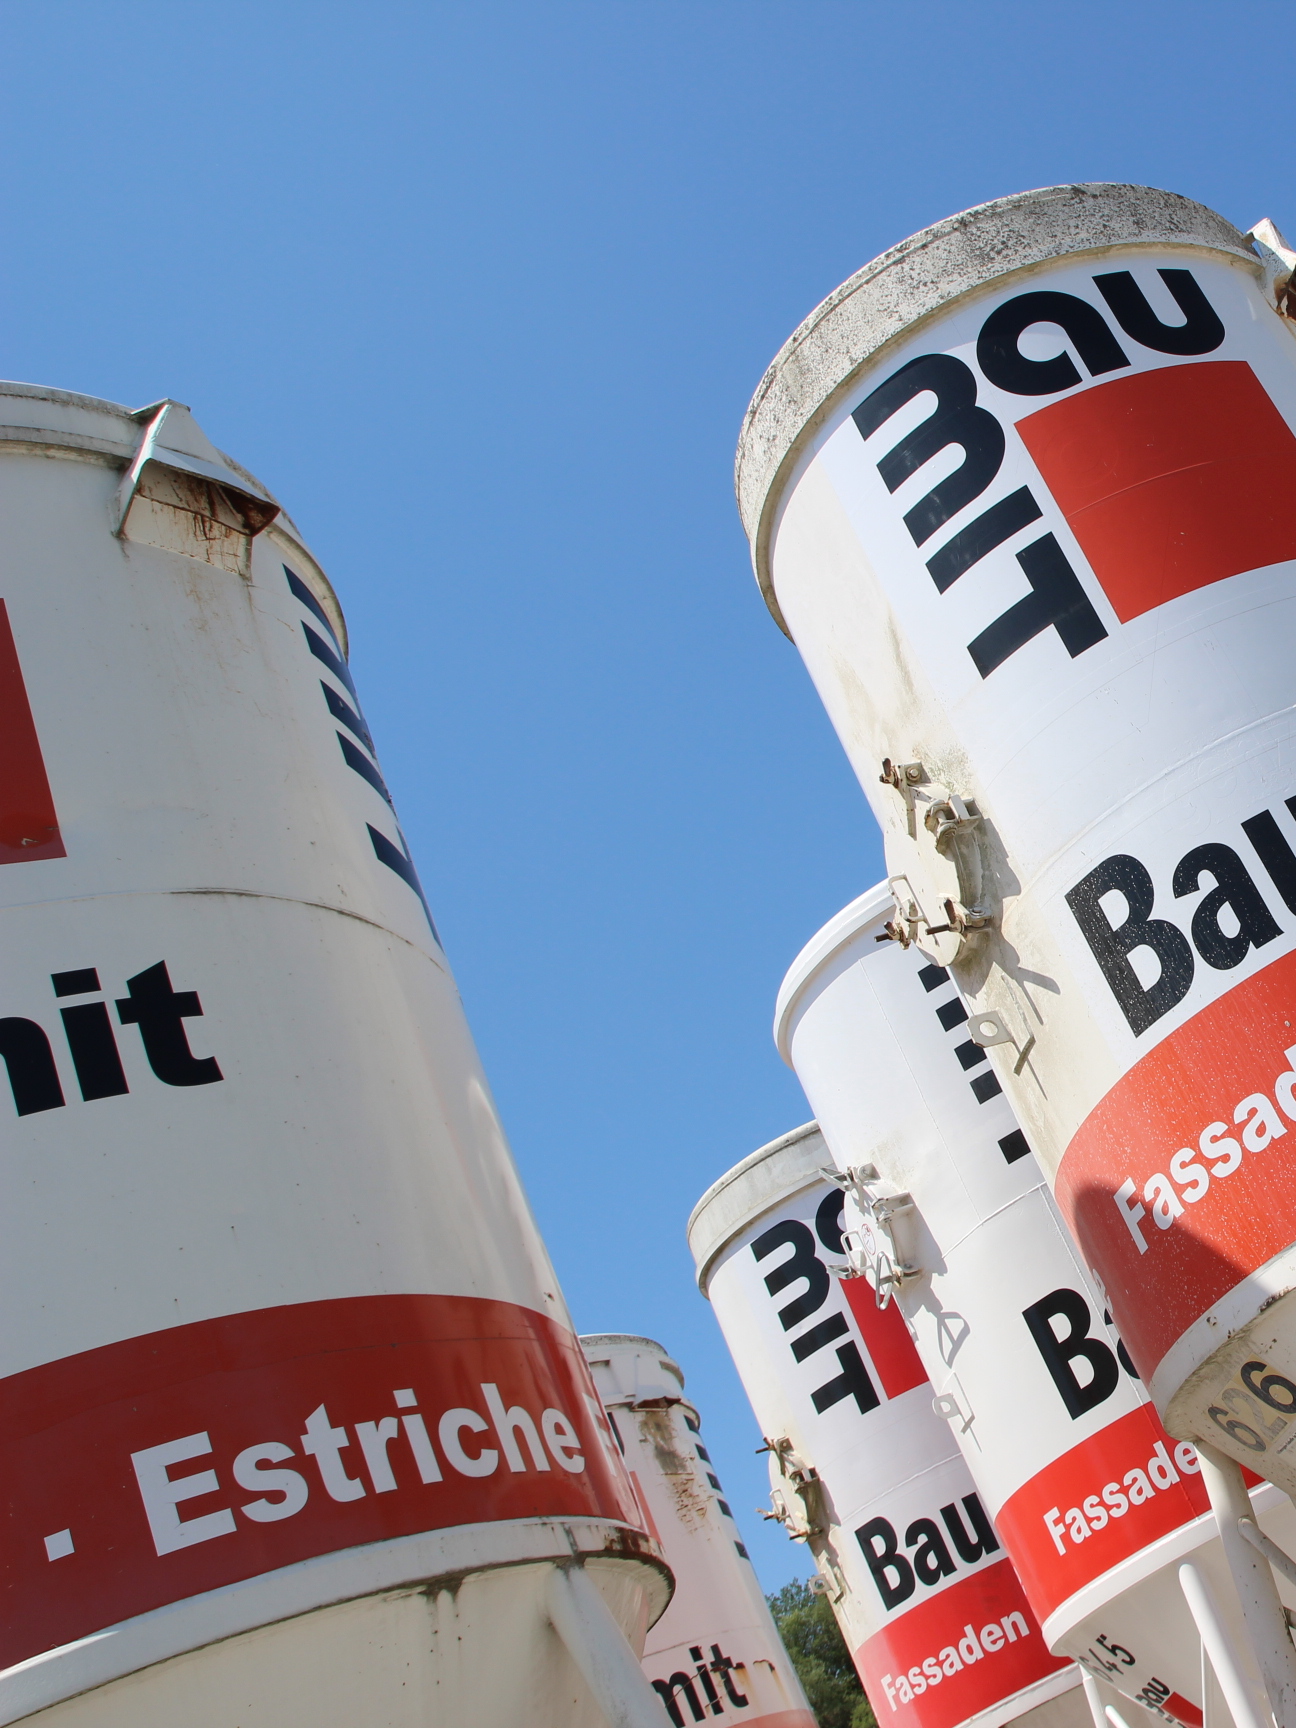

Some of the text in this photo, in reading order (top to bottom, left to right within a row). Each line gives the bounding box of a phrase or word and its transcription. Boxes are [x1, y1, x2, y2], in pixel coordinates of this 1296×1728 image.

[130, 1382, 586, 1557] Estriche
[854, 1491, 1001, 1612] Bau
[881, 1610, 1030, 1712] Fassaden
